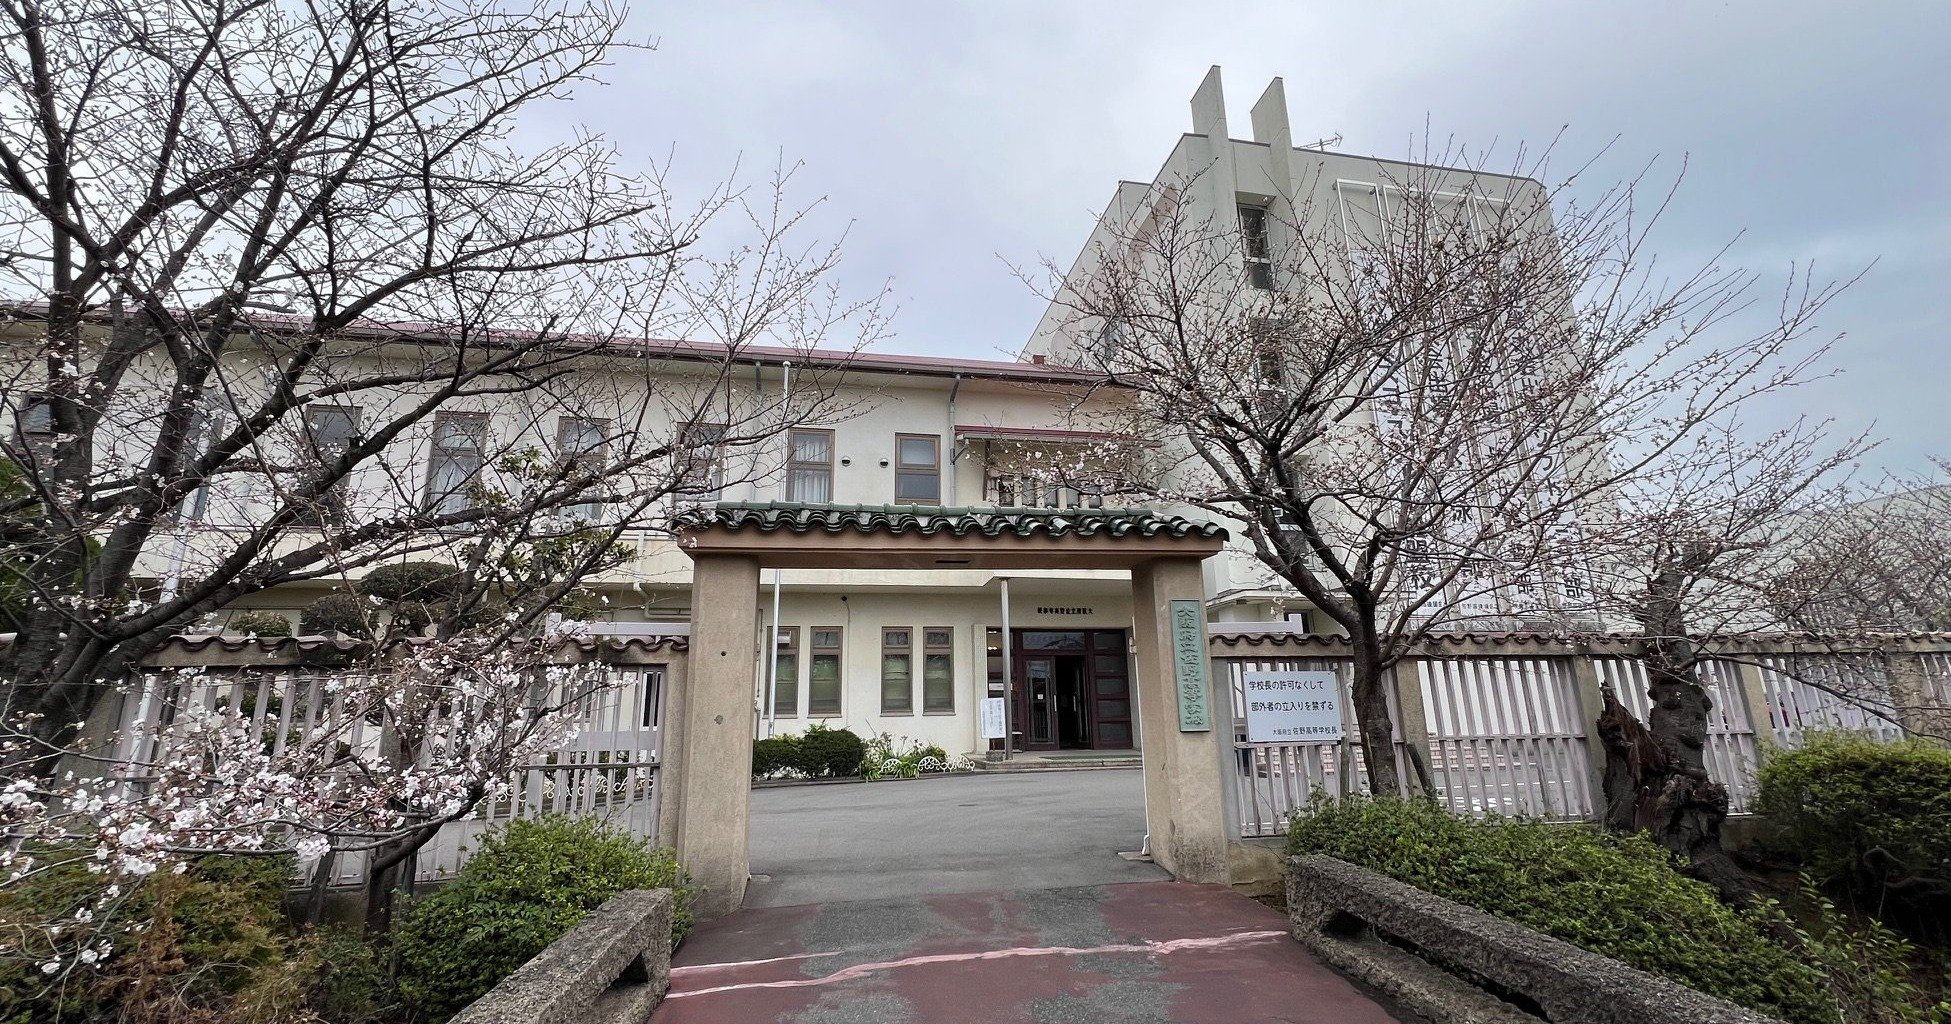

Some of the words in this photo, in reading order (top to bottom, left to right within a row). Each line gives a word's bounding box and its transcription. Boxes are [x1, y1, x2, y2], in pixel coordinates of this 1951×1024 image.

[1249, 680, 1323, 690] 学校長の許可なくして
[1251, 701, 1334, 711] 部外者の立入りを禁ずる
